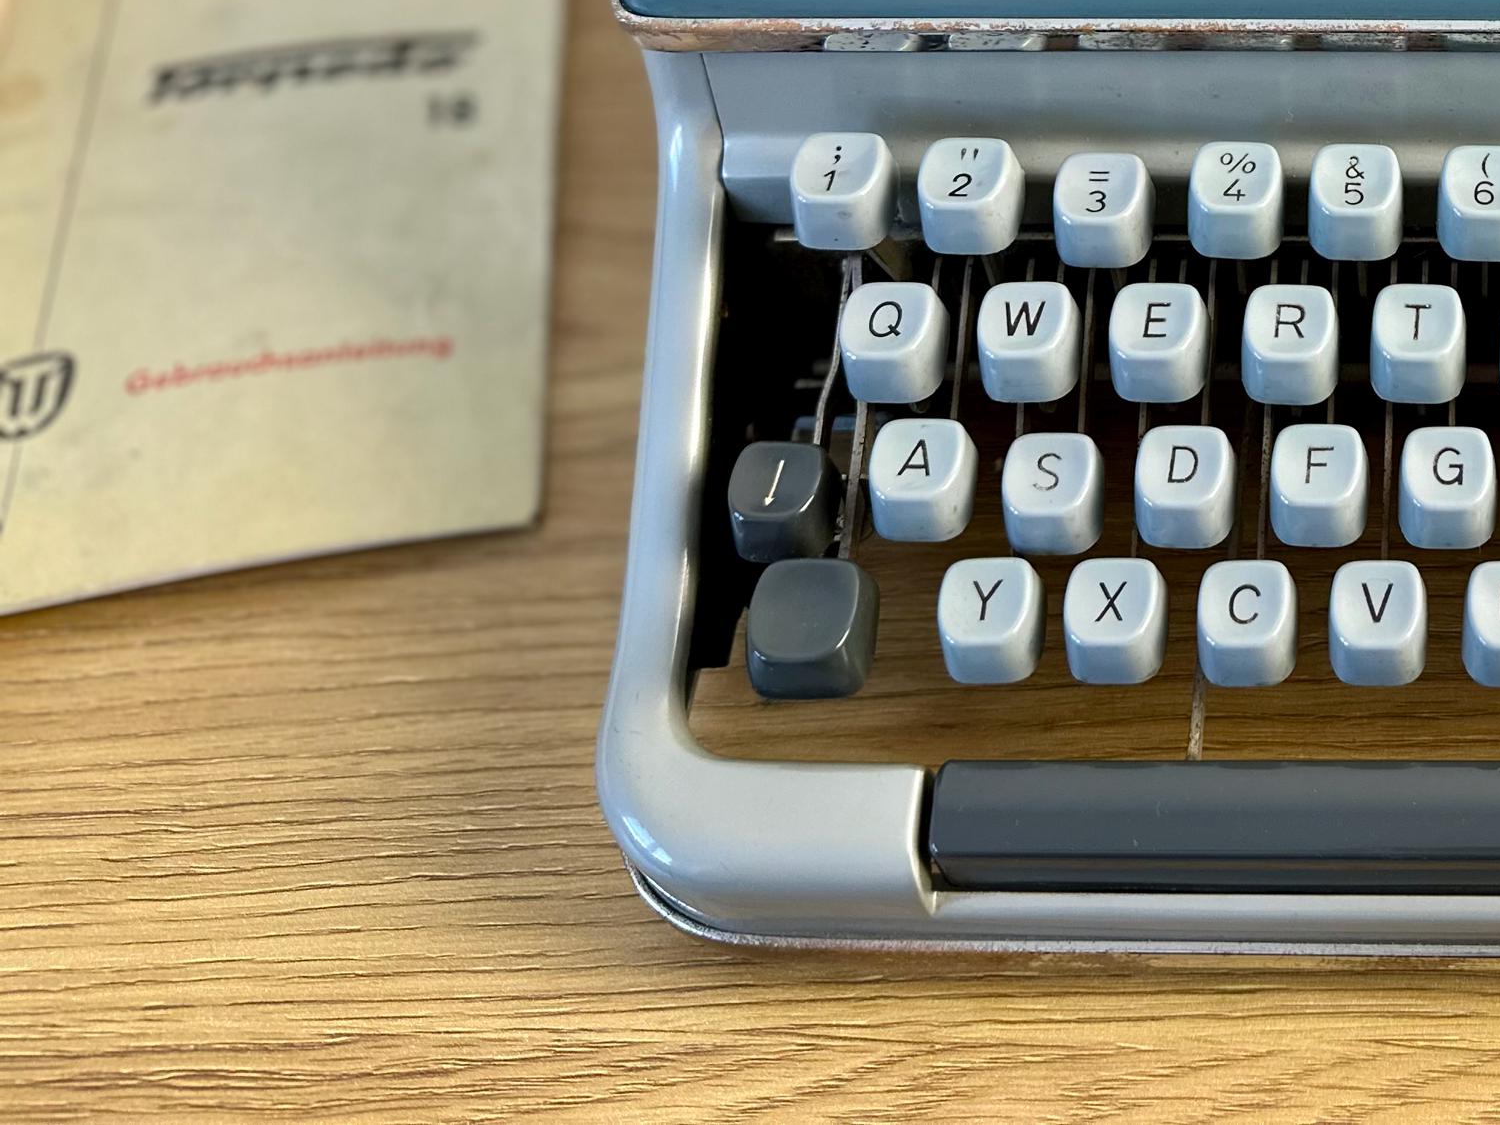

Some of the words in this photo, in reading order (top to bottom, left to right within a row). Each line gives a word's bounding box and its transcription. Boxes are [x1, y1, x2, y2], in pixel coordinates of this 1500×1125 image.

[823, 169, 839, 192] 1
[947, 173, 971, 199] 2
[1089, 171, 1110, 182] =
[1345, 156, 1365, 180] &
[1085, 190, 1110, 213] 3
[1223, 180, 1247, 202] 4
[1344, 182, 1364, 206] 5
[1474, 181, 1494, 205] 6
[869, 301, 905, 339] Q
[1005, 301, 1048, 339] W
[1142, 302, 1172, 338] E
[1274, 304, 1309, 339] R
[1404, 304, 1432, 341] T
[898, 439, 930, 477] A
[1033, 453, 1062, 491] S
[1167, 445, 1199, 483] D
[1305, 446, 1334, 484] F
[1433, 447, 1465, 486] G
[973, 579, 1004, 621] Y
[1094, 581, 1127, 622] X
[1229, 584, 1261, 625] C
[1361, 580, 1394, 623] V
